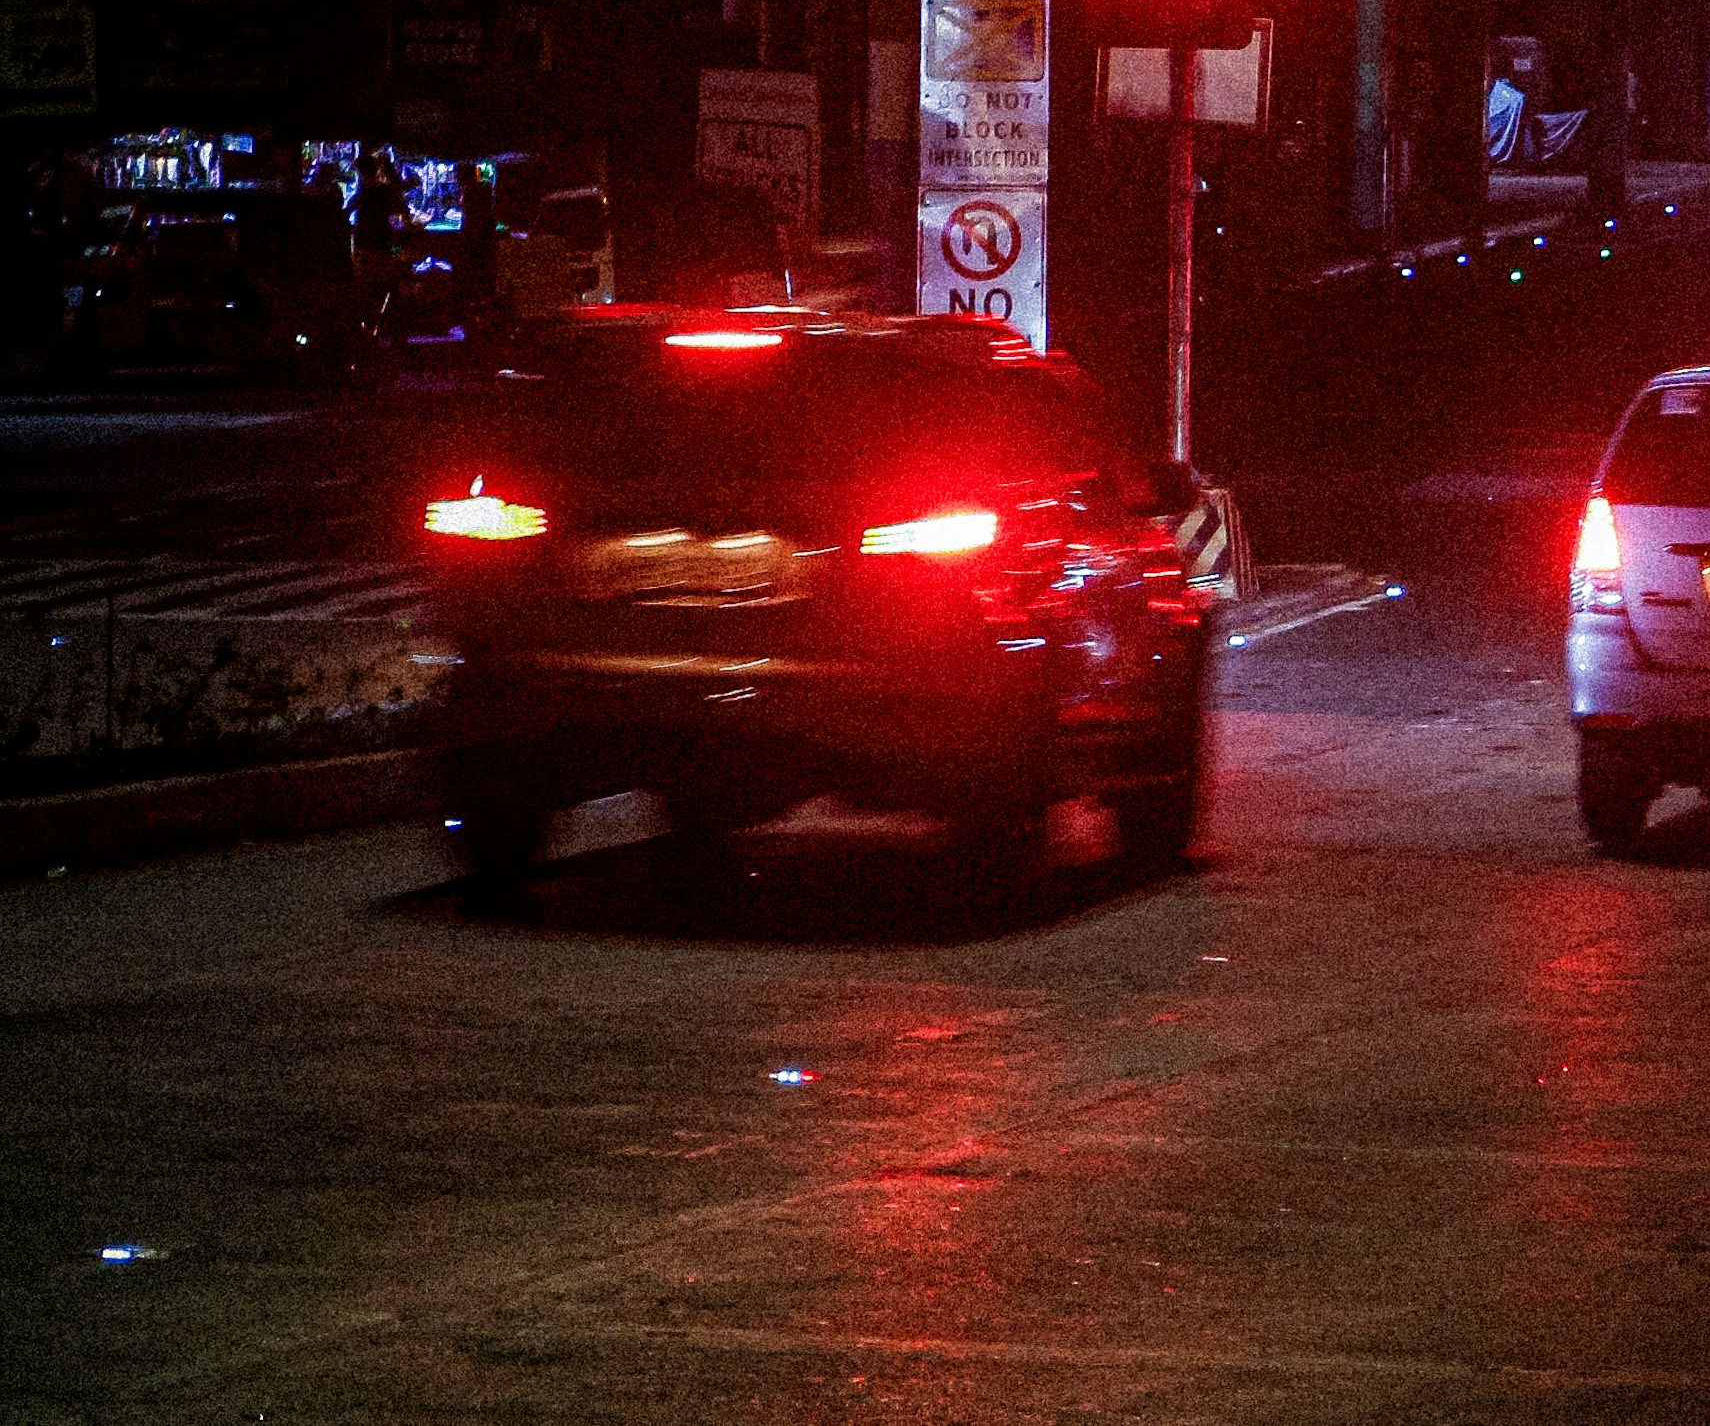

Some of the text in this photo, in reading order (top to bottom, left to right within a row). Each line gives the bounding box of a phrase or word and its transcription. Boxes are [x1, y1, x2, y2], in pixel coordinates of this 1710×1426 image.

[938, 90, 1032, 109] DO NOT
[945, 121, 1023, 139] BLOCK
[928, 149, 1039, 167] INTERSECTION
[950, 288, 1012, 320] NO
